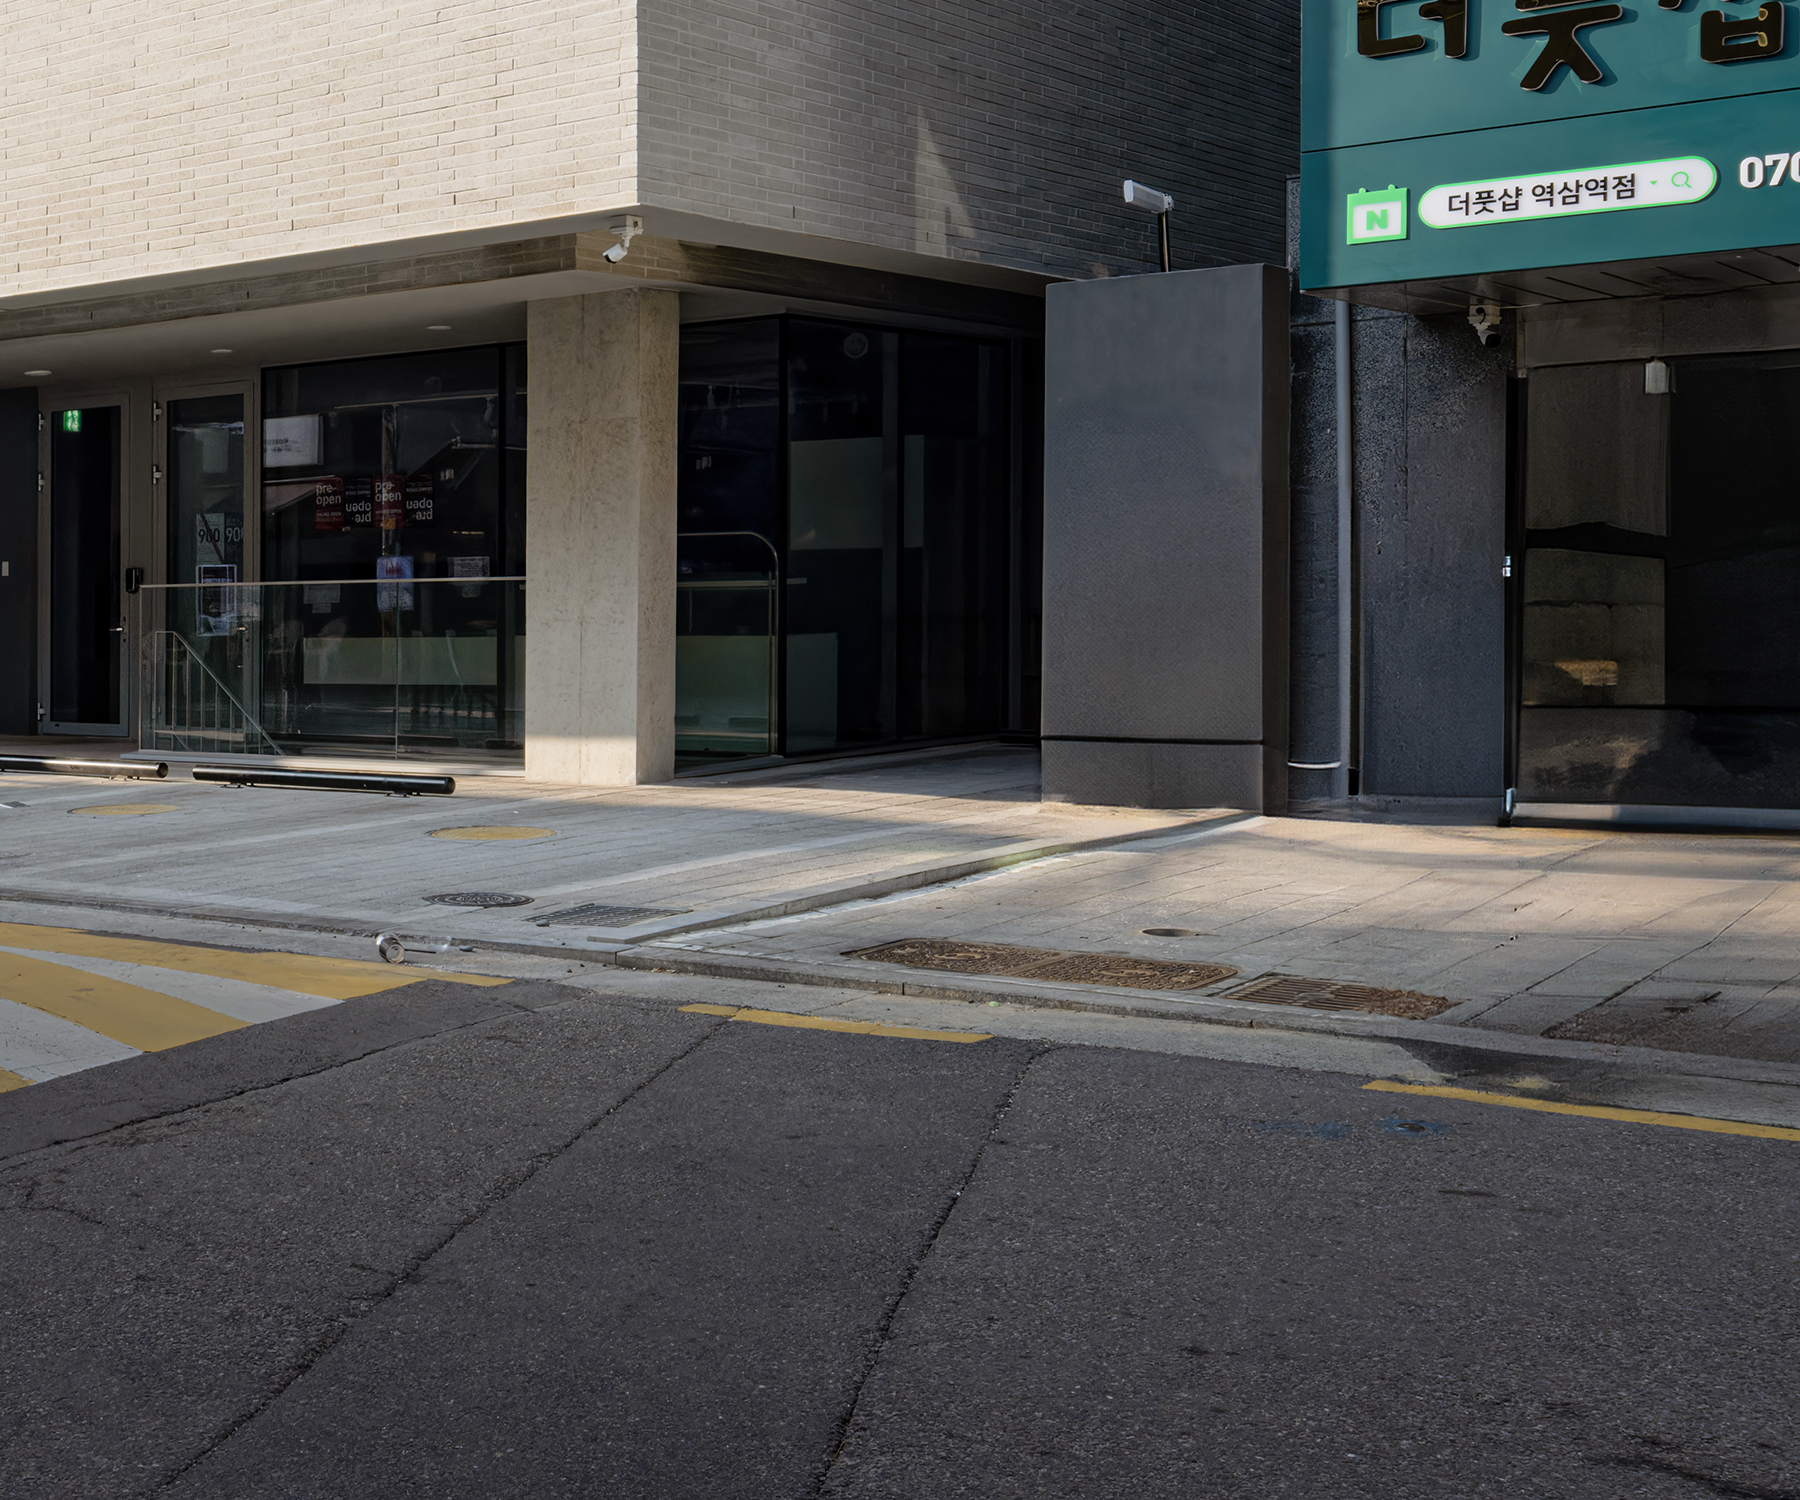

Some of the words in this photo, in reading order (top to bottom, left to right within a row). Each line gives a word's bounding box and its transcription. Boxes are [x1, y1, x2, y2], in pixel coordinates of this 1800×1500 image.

[1448, 185, 1523, 216] 더풋샵
[1531, 173, 1636, 207] 역삼역점
[1366, 209, 1388, 230] N
[316, 494, 342, 506] open
[375, 492, 402, 504] open
